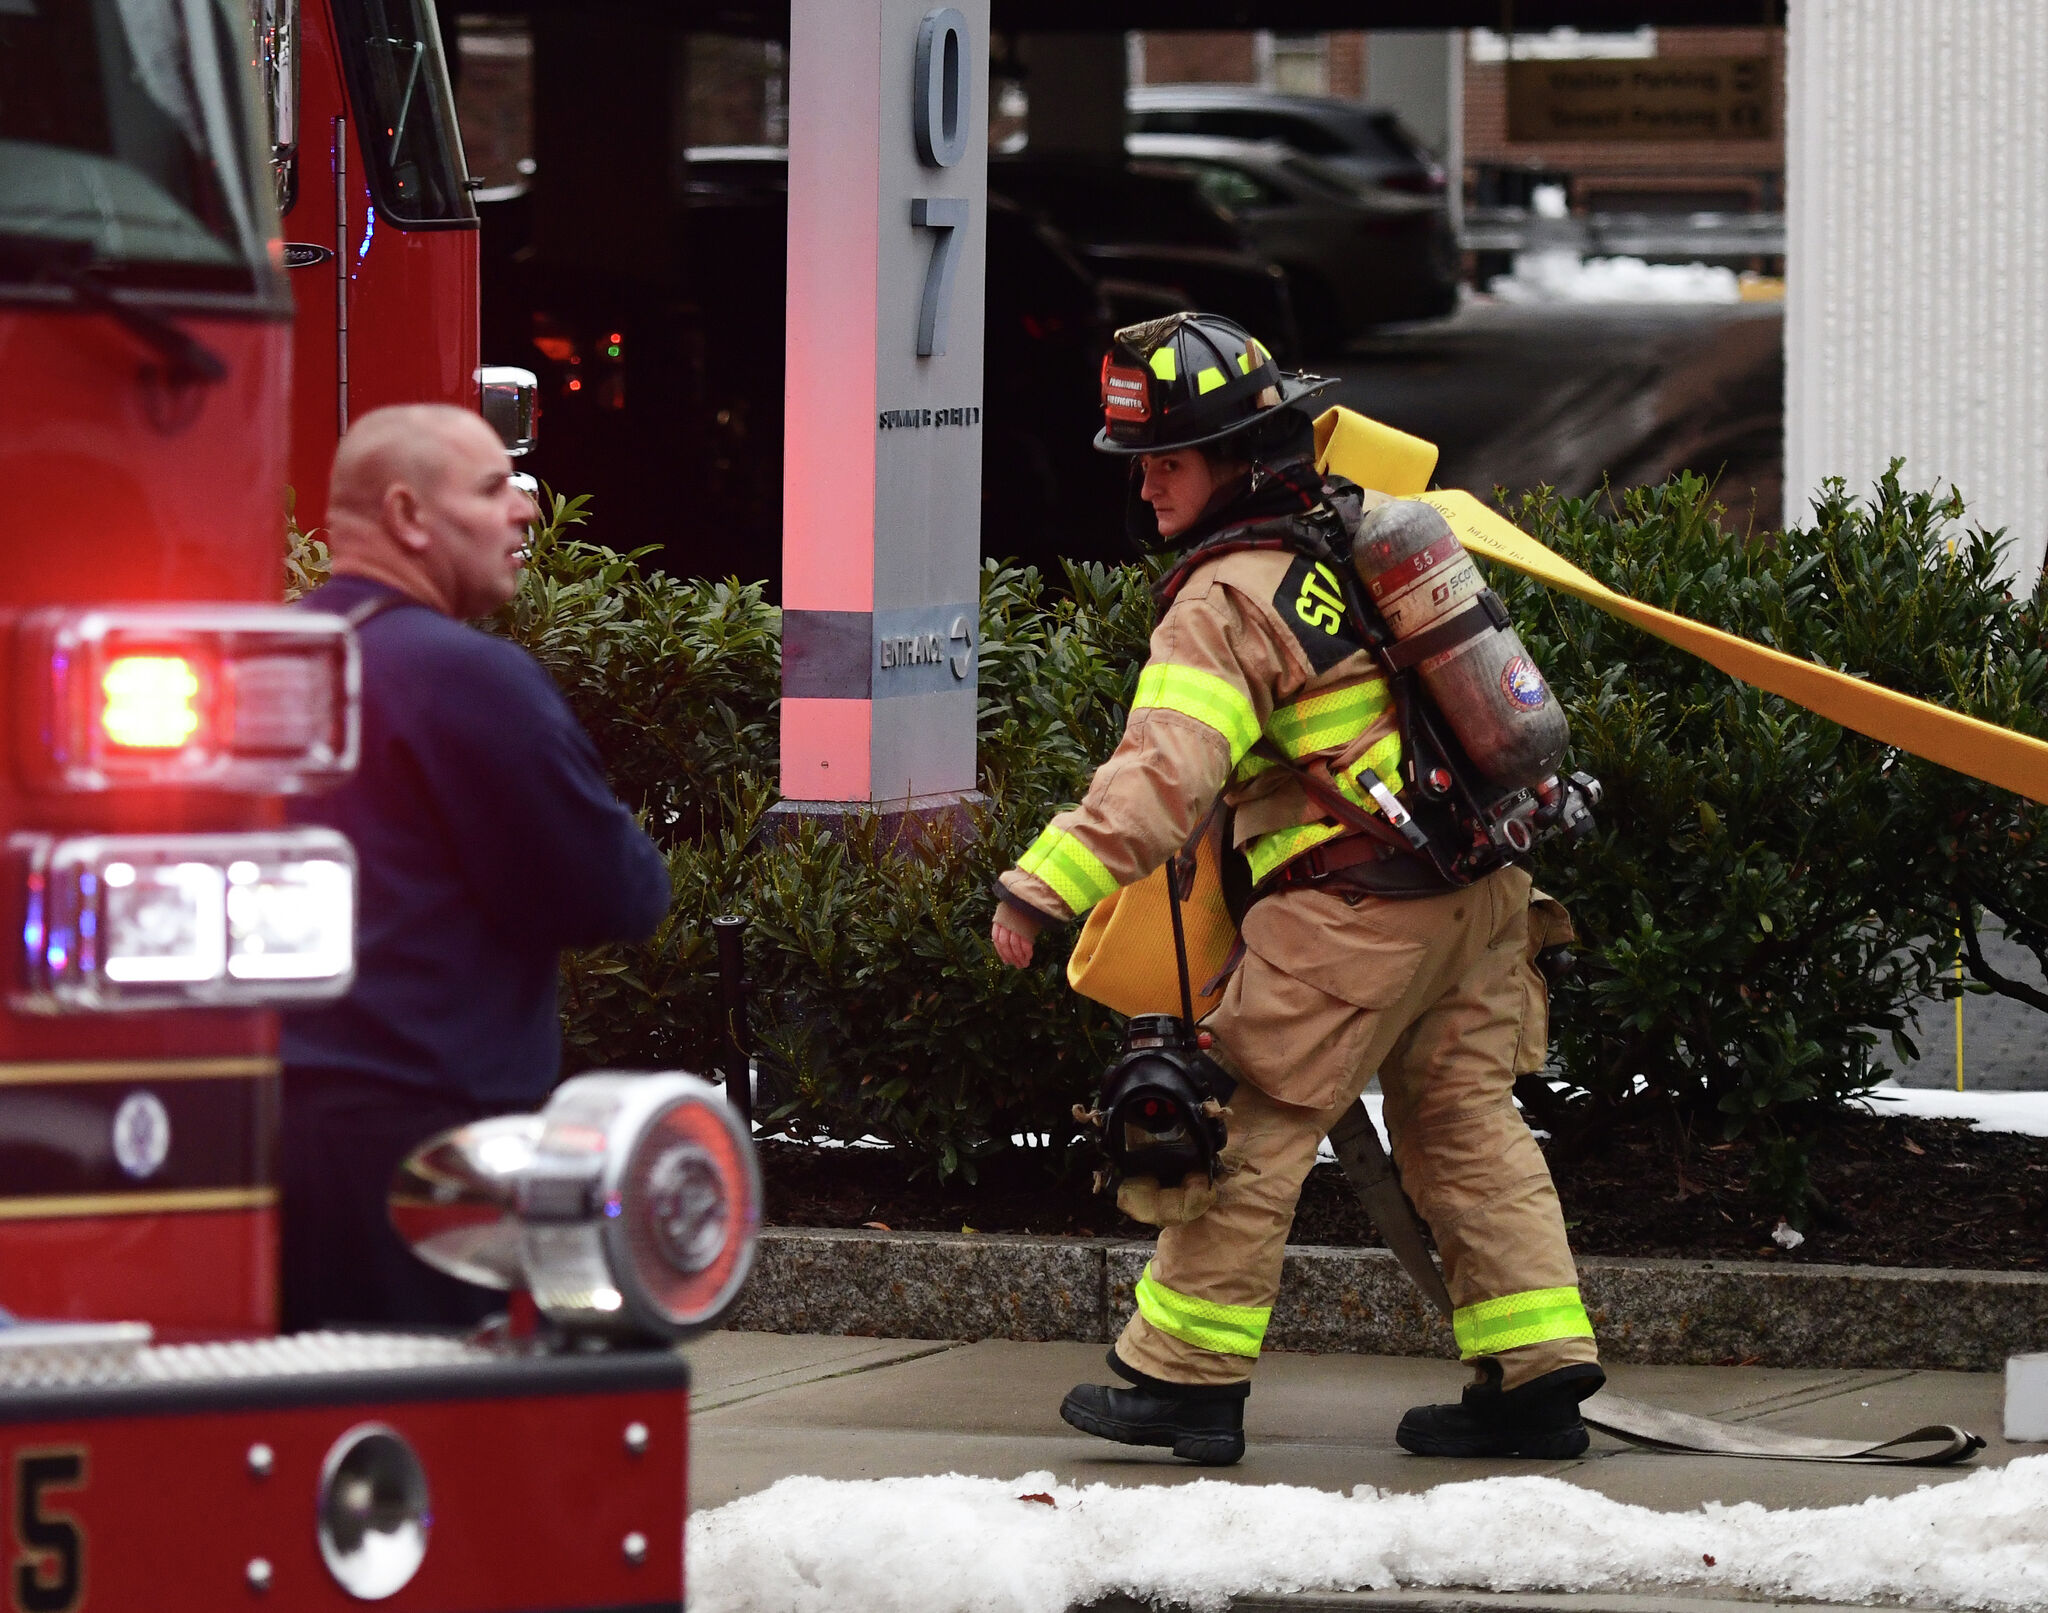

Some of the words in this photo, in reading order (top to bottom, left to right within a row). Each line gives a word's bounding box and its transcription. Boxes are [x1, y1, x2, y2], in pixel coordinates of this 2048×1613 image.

[1107, 395, 1142, 408] FIREFIGHTER
[935, 406, 980, 428] STREET
[1466, 526, 1506, 551] MADE
[1413, 550, 1434, 572] 5.5
[881, 634, 944, 668] ENTRANCE
[14, 1447, 89, 1613] 5
